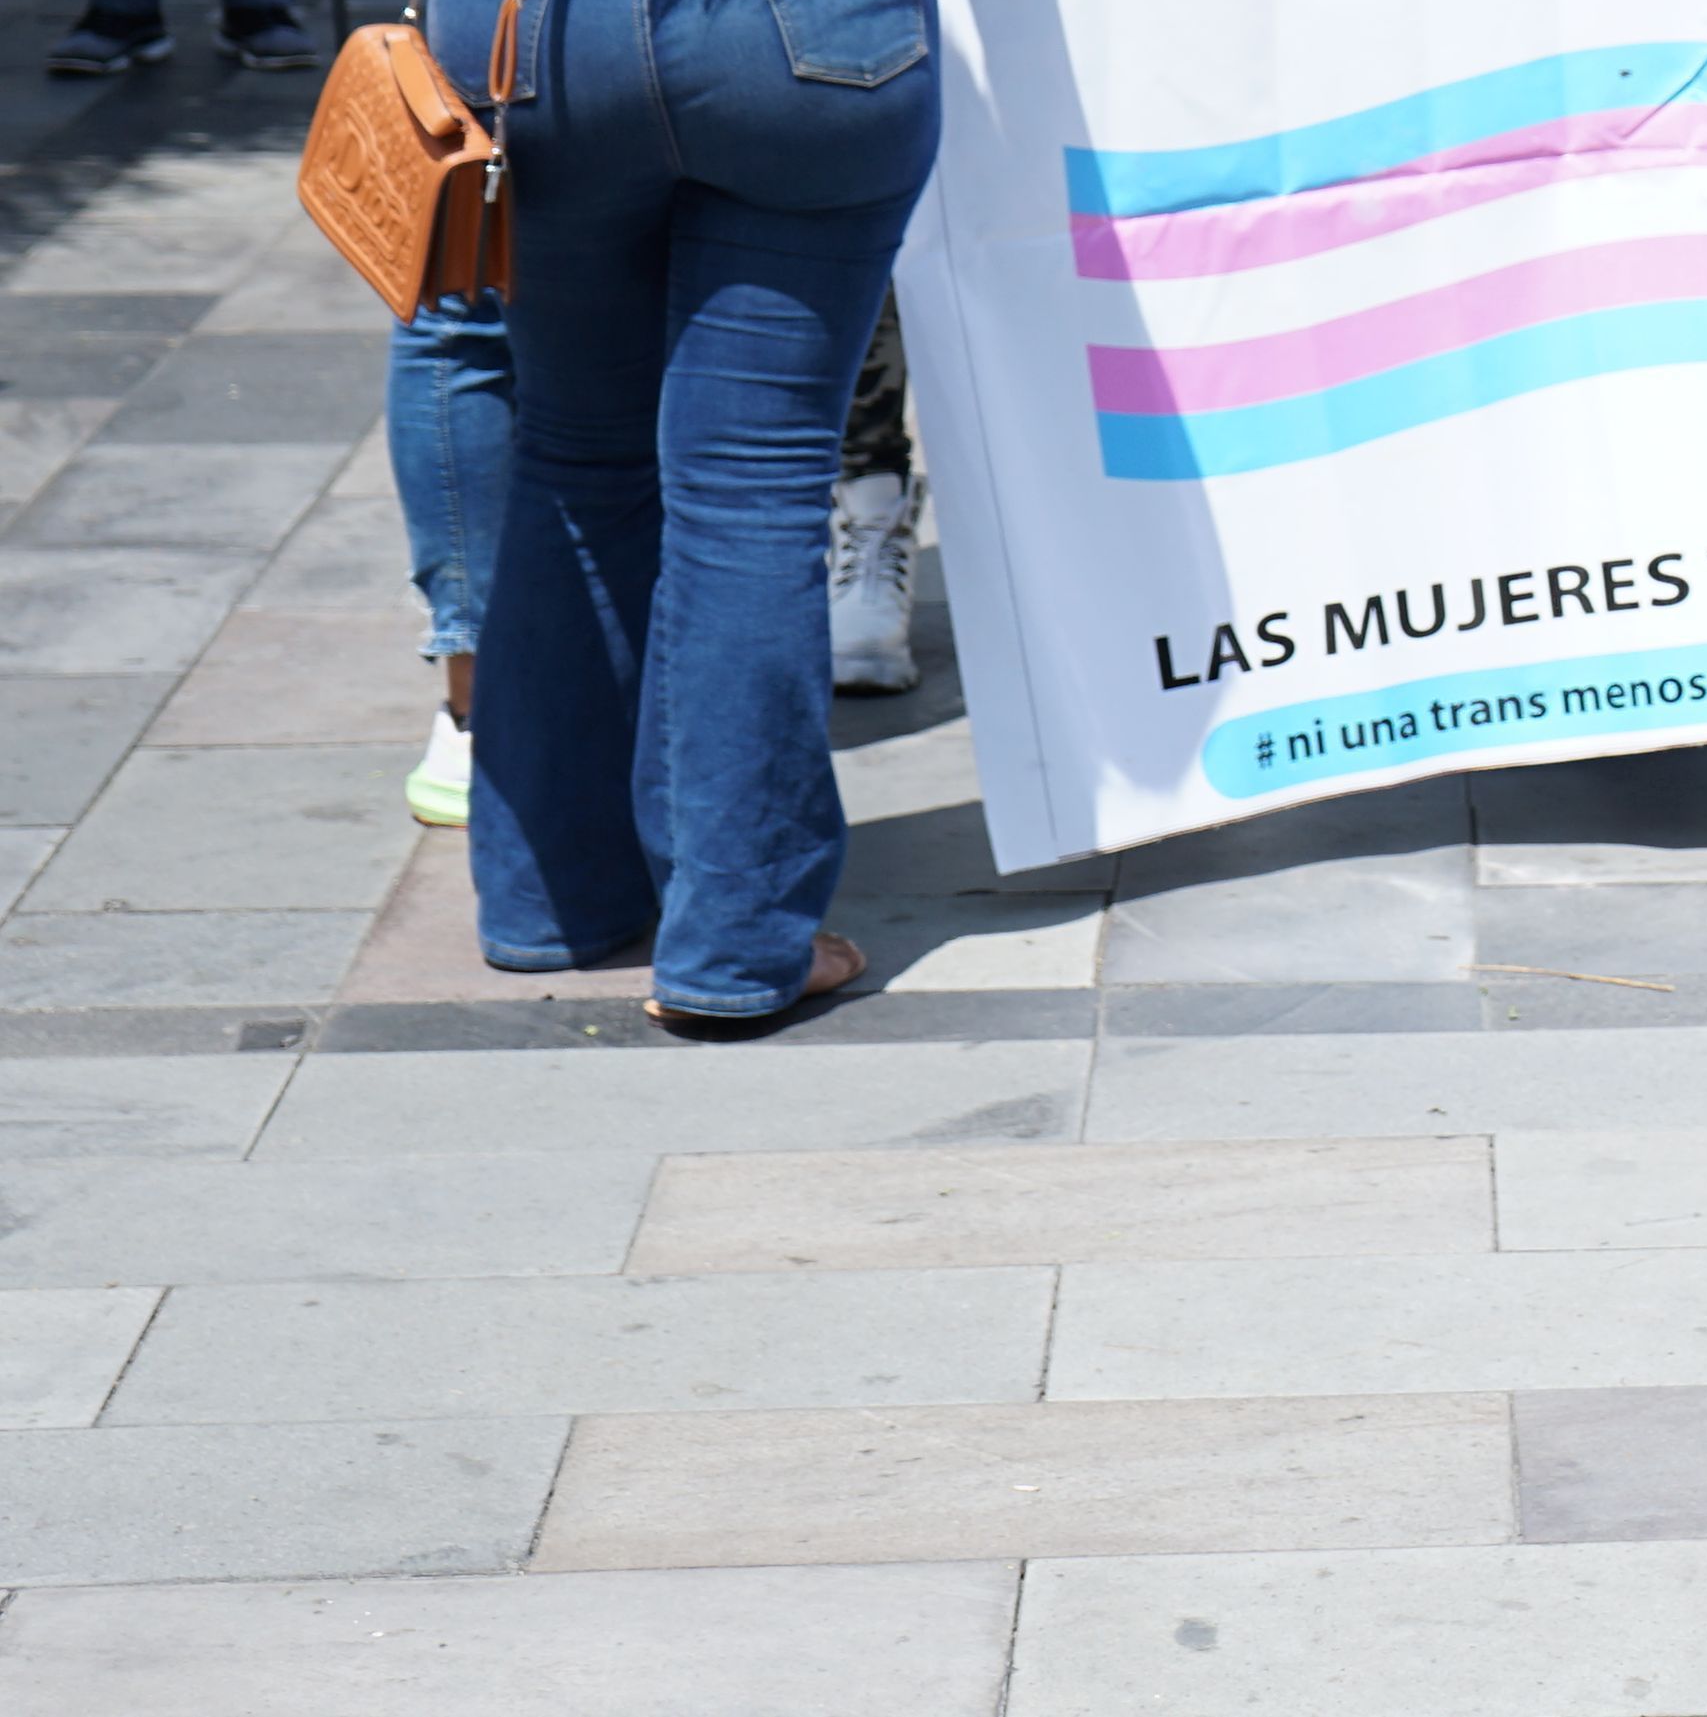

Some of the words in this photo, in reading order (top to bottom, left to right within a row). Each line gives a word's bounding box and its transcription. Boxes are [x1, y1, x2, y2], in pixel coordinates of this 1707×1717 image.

[1155, 612, 1296, 690] LAS
[1324, 552, 1690, 656] MUJERES
[1287, 717, 1326, 762] ni
[1340, 710, 1419, 751] una
[1429, 691, 1548, 733] trans
[1561, 673, 1707, 715] menos
